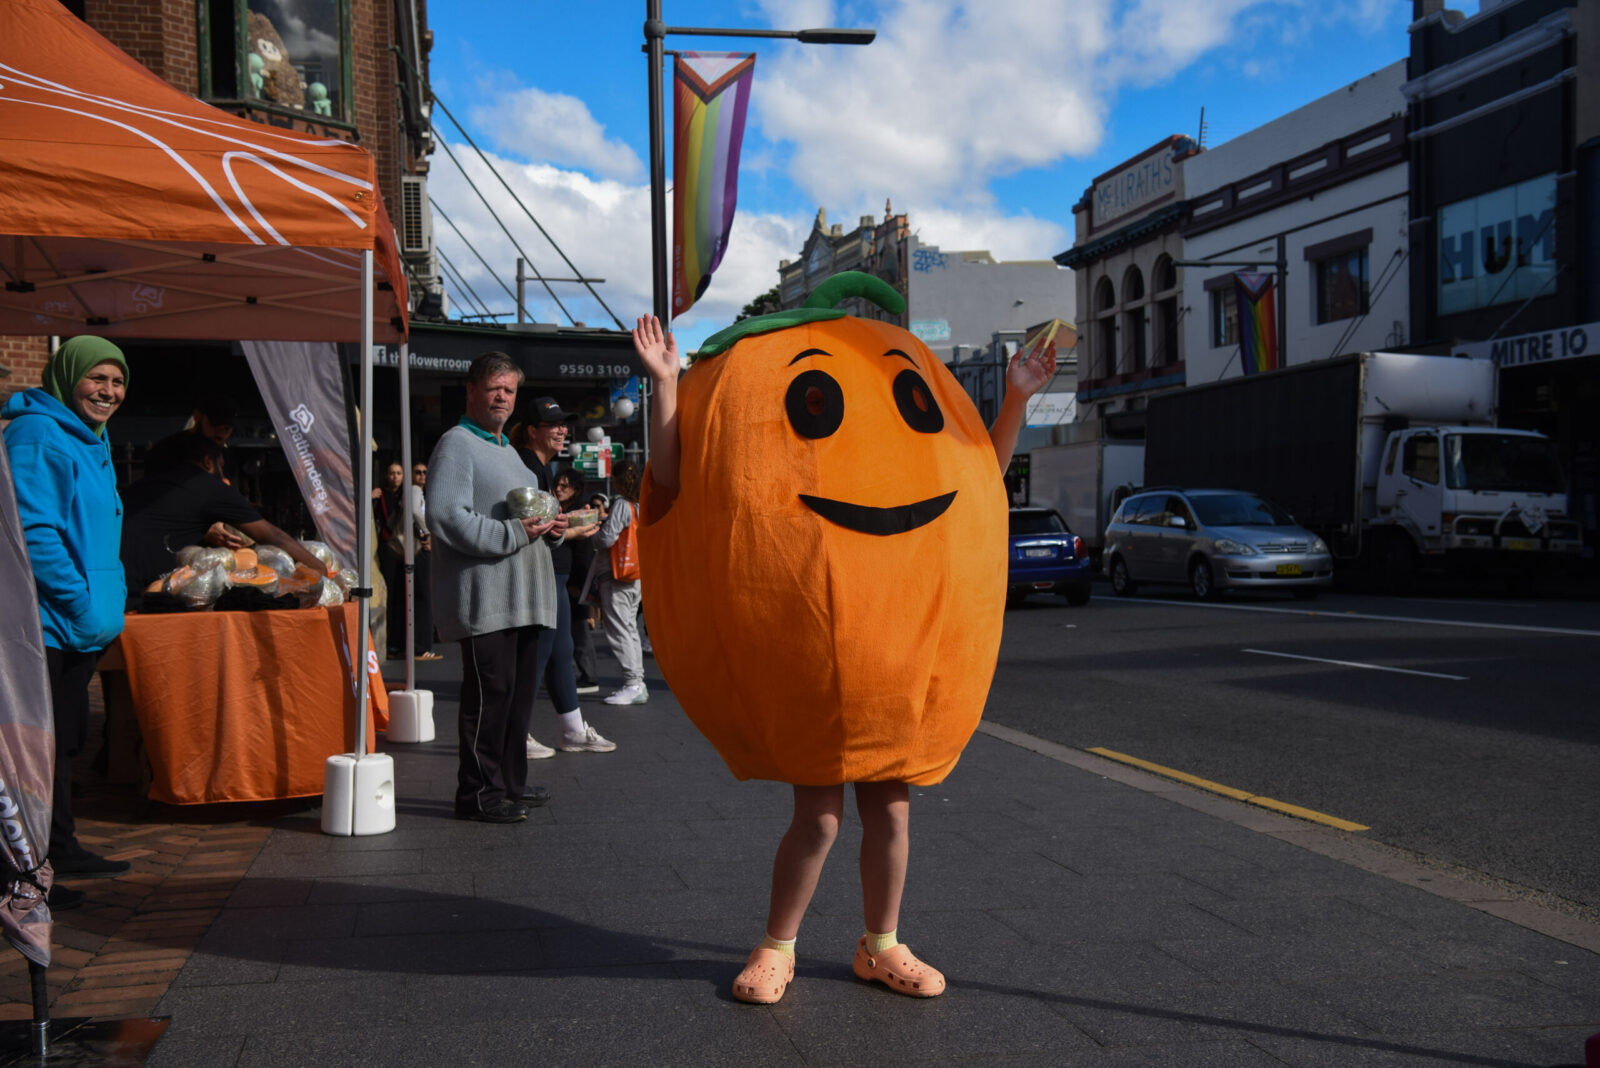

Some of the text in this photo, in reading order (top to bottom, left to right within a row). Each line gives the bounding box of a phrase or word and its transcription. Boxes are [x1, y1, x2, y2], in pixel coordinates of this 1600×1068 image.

[1491, 328, 1587, 365] MITRE 10
[559, 364, 631, 375] 9550 3100
[284, 423, 328, 501] pathfinders
